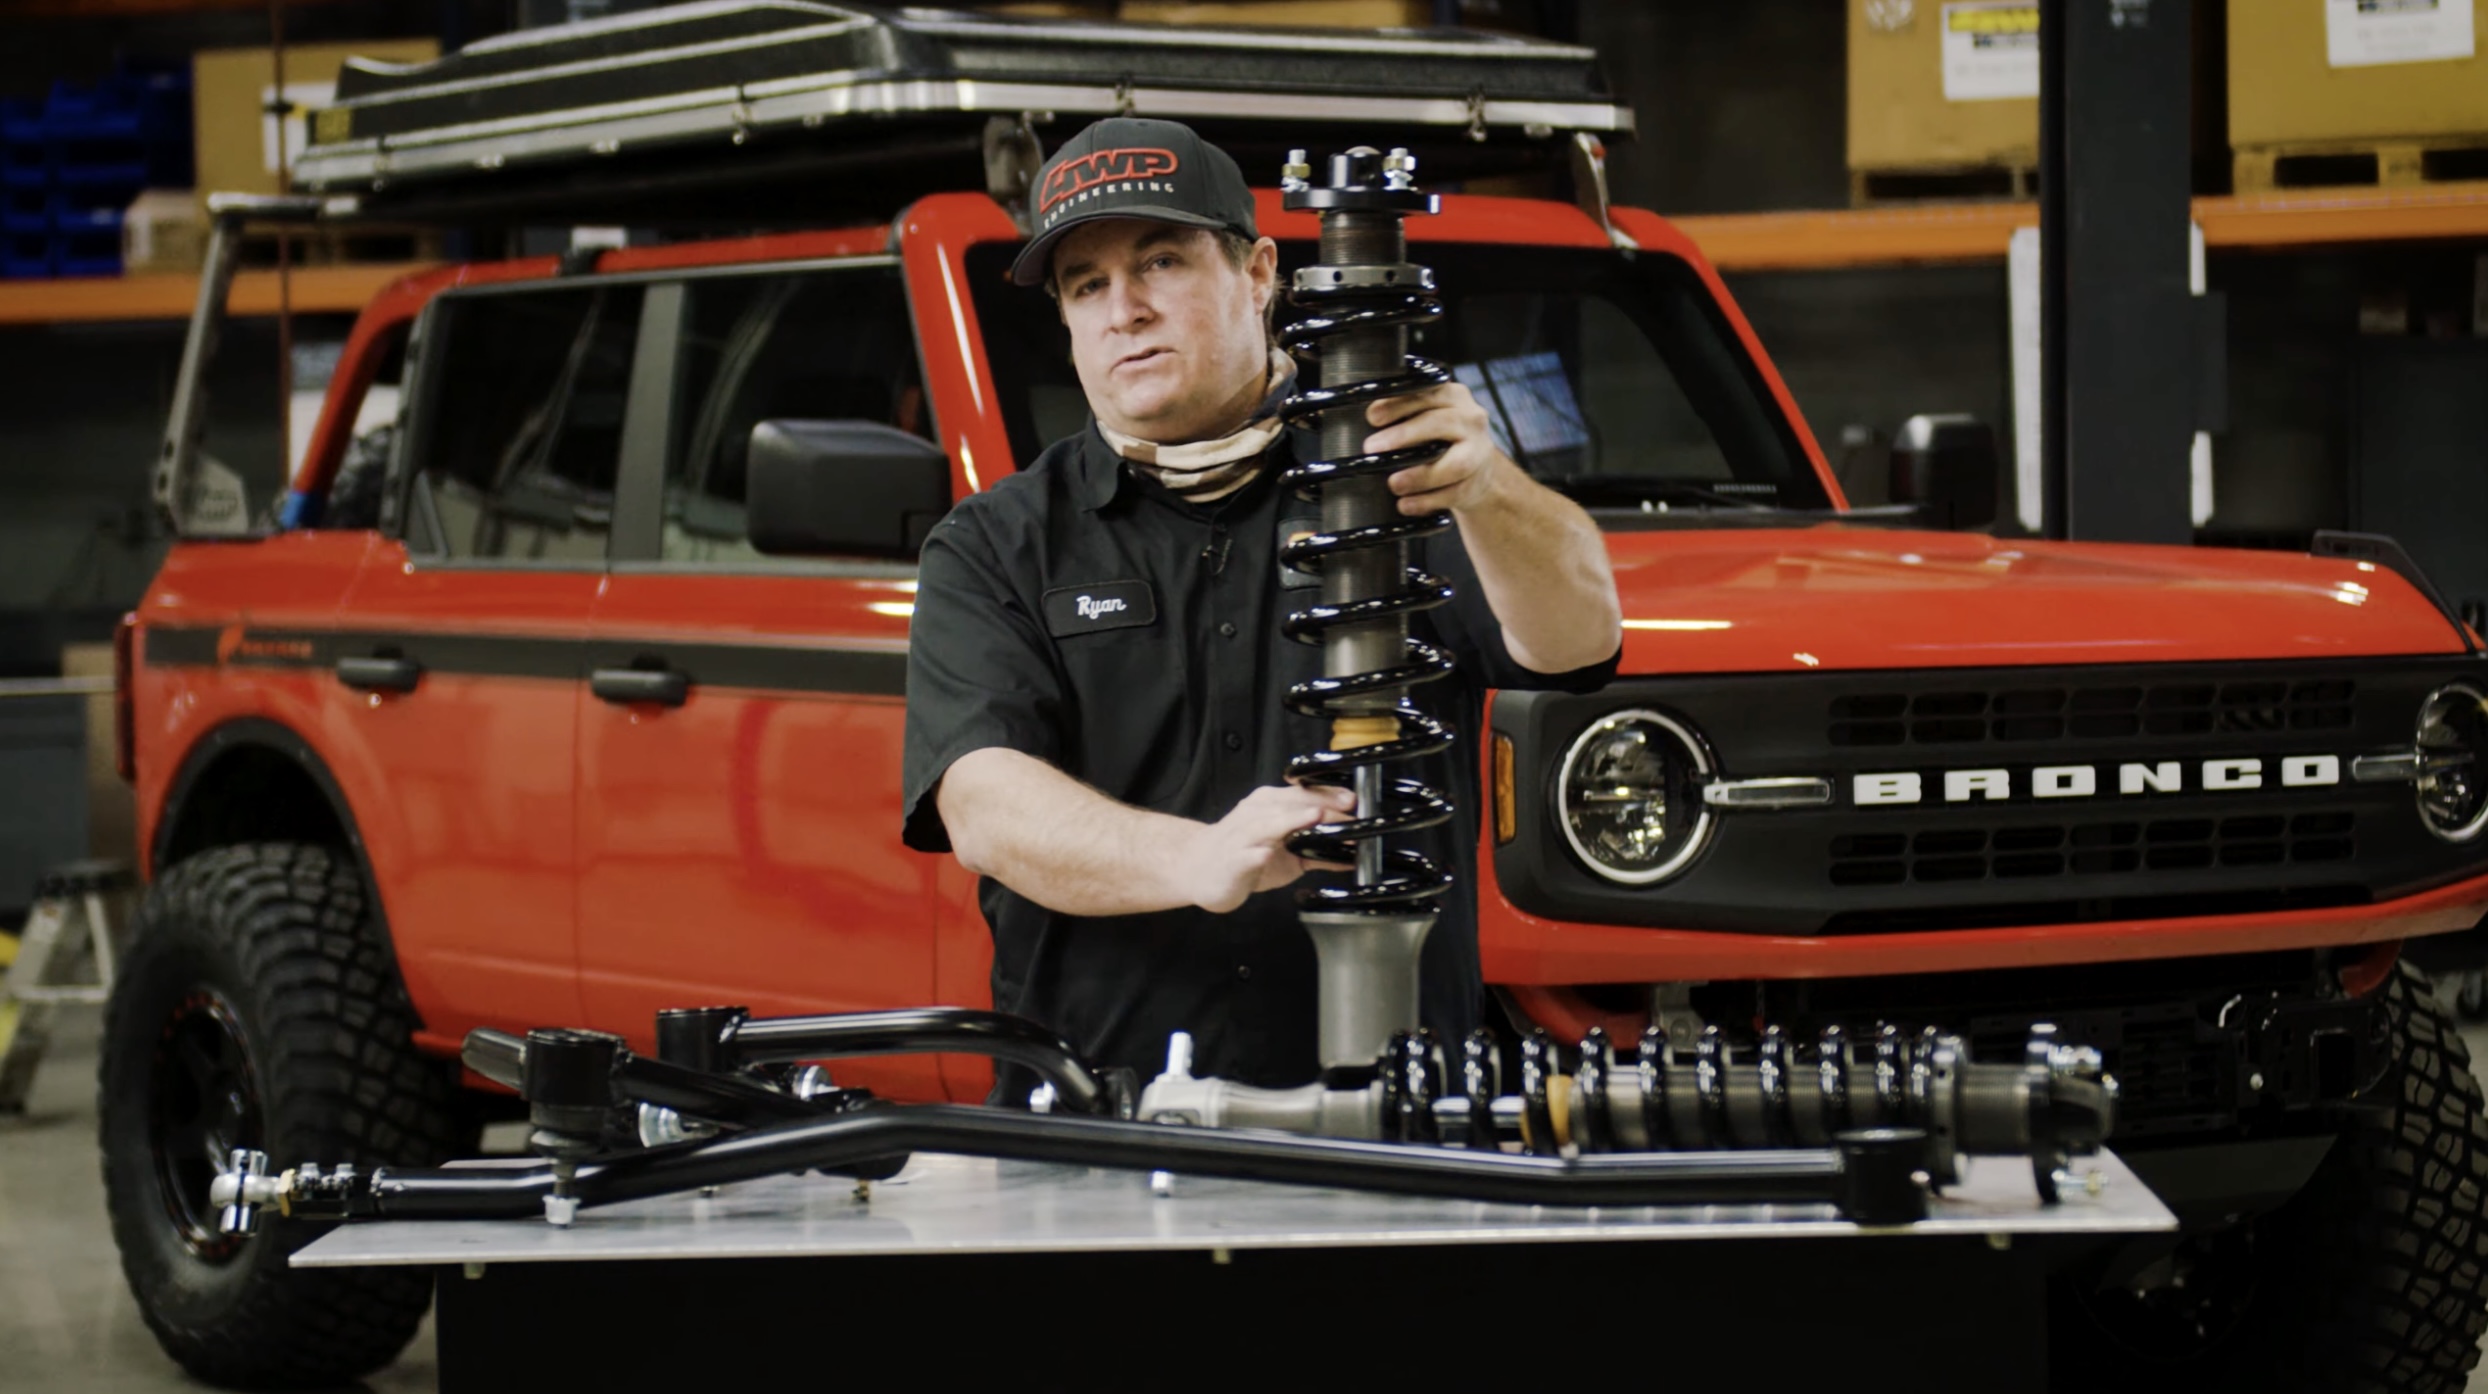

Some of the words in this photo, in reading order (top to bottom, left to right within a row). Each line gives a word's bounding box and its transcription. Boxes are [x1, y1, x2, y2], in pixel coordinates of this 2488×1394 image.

[1043, 181, 1175, 230] ENGINEERING
[1076, 595, 1127, 620] Ryan
[1853, 755, 2340, 806] BRONCO
